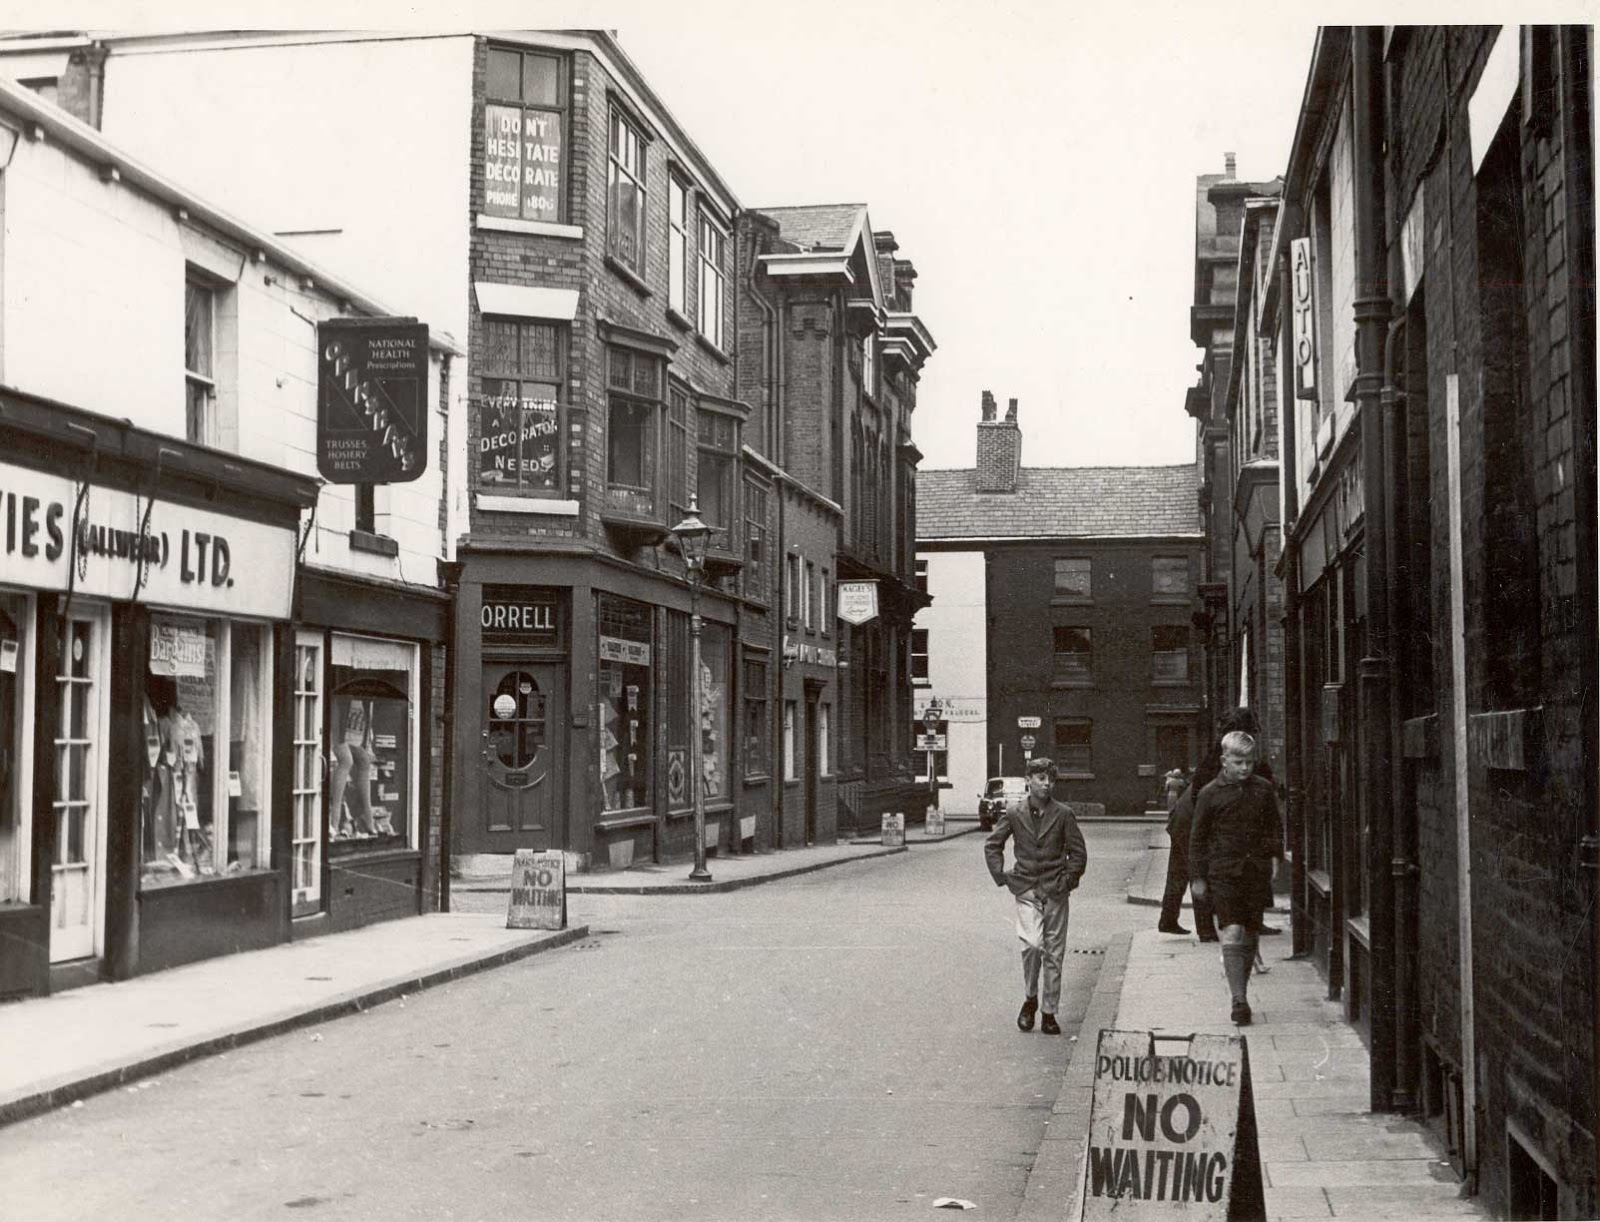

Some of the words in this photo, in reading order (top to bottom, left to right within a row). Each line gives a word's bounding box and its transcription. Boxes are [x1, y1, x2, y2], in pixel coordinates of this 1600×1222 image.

[501, 115, 547, 137] DON'T
[487, 138, 559, 163] HESITATE
[486, 161, 559, 187] DECORATE
[486, 190, 518, 207] PHONE
[1296, 241, 1311, 365] AUTO
[368, 339, 416, 349] NATIONAL
[371, 350, 410, 359] HEALTH
[366, 360, 416, 370] Prescriptions
[492, 419, 499, 427] A
[326, 439, 367, 449] TRUSSES
[328, 450, 367, 460] HOSIERY
[334, 460, 361, 470] BELTS
[0, 490, 64, 562] IES
[180, 529, 234, 588] LTD.
[481, 605, 555, 629] ORRELL
[152, 624, 203, 673] Bargains
[523, 870, 552, 887] NO
[512, 888, 561, 907] WAITING
[1097, 1055, 1165, 1083] POLICE
[1168, 1058, 1236, 1087] NOTICE
[1122, 1092, 1202, 1144] NO
[1090, 1146, 1227, 1203] WAITING
